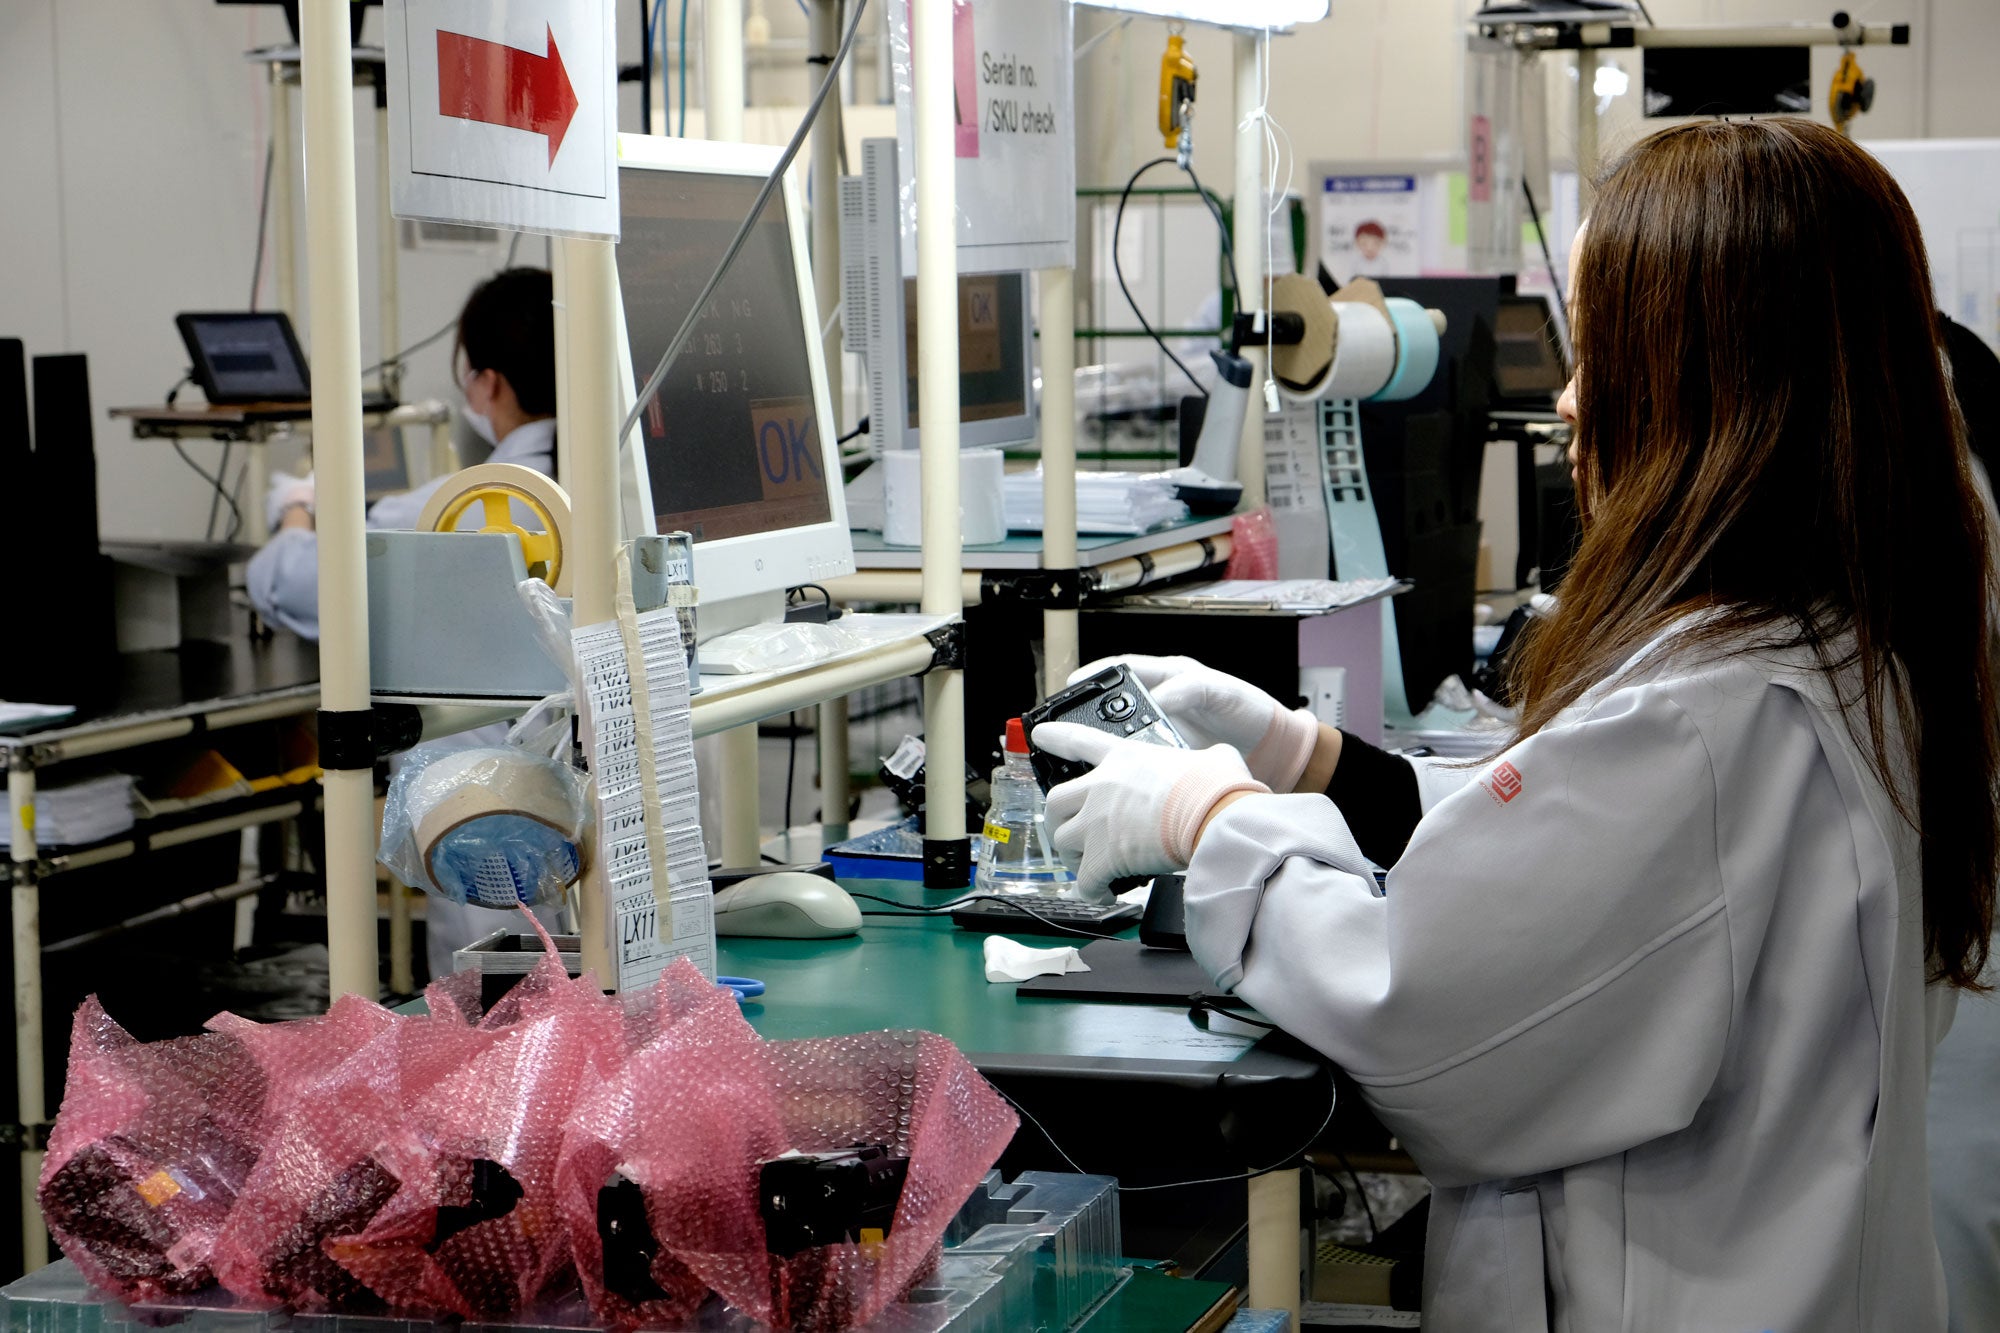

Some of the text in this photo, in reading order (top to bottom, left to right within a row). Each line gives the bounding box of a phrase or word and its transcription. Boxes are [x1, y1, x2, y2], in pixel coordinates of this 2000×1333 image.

[982, 50, 1038, 87] Serial no.
[984, 97, 1019, 133] /SKU
[1022, 101, 1057, 134] check
[731, 298, 752, 318] NG
[972, 293, 993, 322] OK
[709, 370, 728, 393] 250
[760, 417, 821, 484] OK
[667, 563, 688, 577] LX11
[624, 908, 655, 945] LX11
